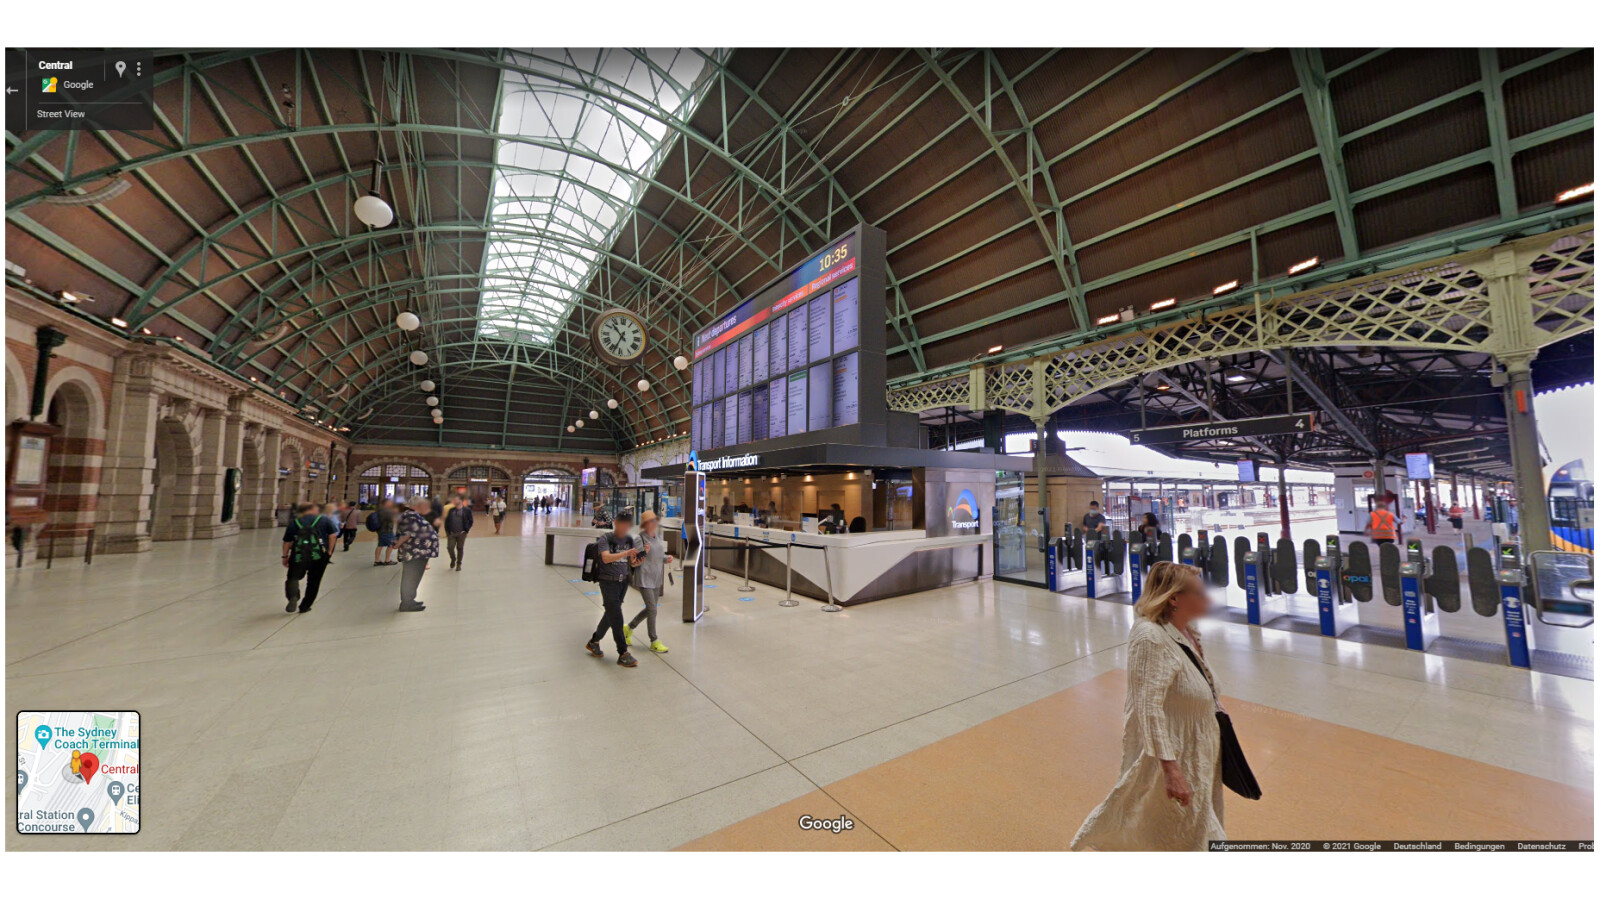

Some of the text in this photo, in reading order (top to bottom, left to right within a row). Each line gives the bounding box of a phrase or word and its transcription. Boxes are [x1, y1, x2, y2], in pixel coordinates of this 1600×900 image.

[819, 243, 848, 272] 10:35
[711, 315, 737, 337] departures
[1133, 418, 1305, 443] 5 Platforms 4
[697, 453, 758, 472] Transport Information
[951, 520, 979, 530] Transport
